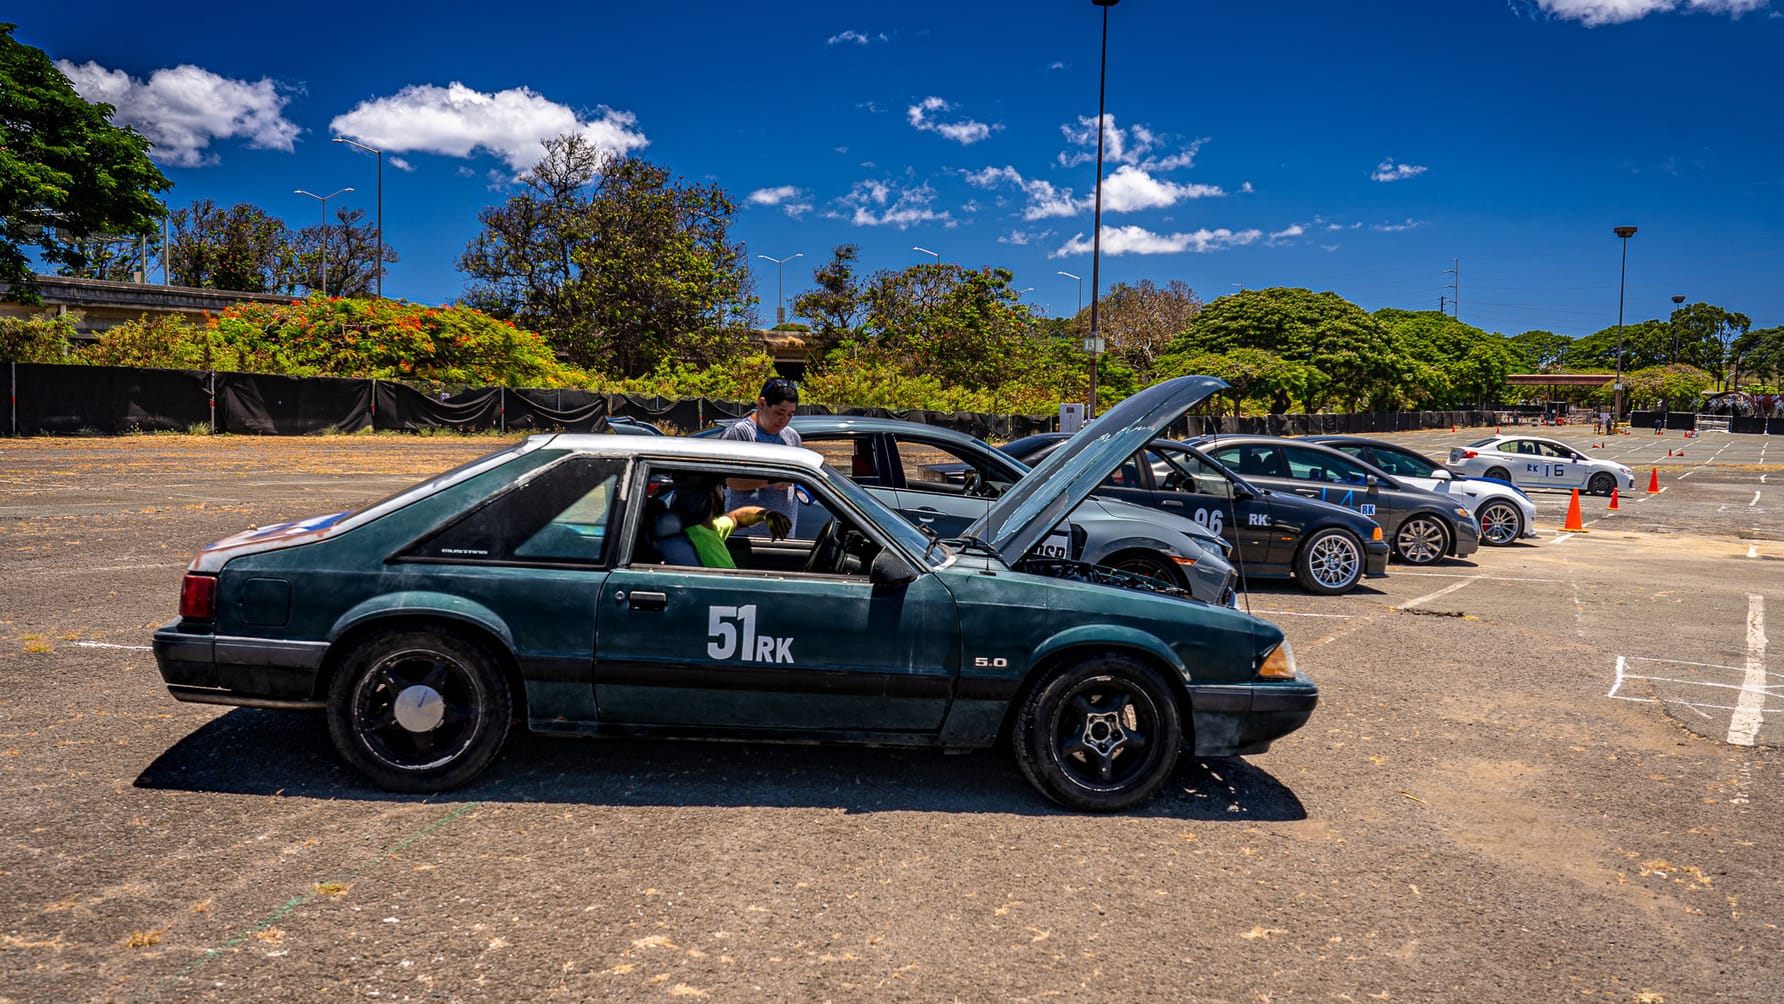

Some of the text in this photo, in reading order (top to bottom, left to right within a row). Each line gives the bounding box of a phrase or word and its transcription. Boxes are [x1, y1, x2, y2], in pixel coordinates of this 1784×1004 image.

[1527, 463, 1564, 477] RK 16
[1362, 505, 1375, 515] RK
[1194, 507, 1271, 536] 96 RK
[975, 657, 1008, 667] 5.0
